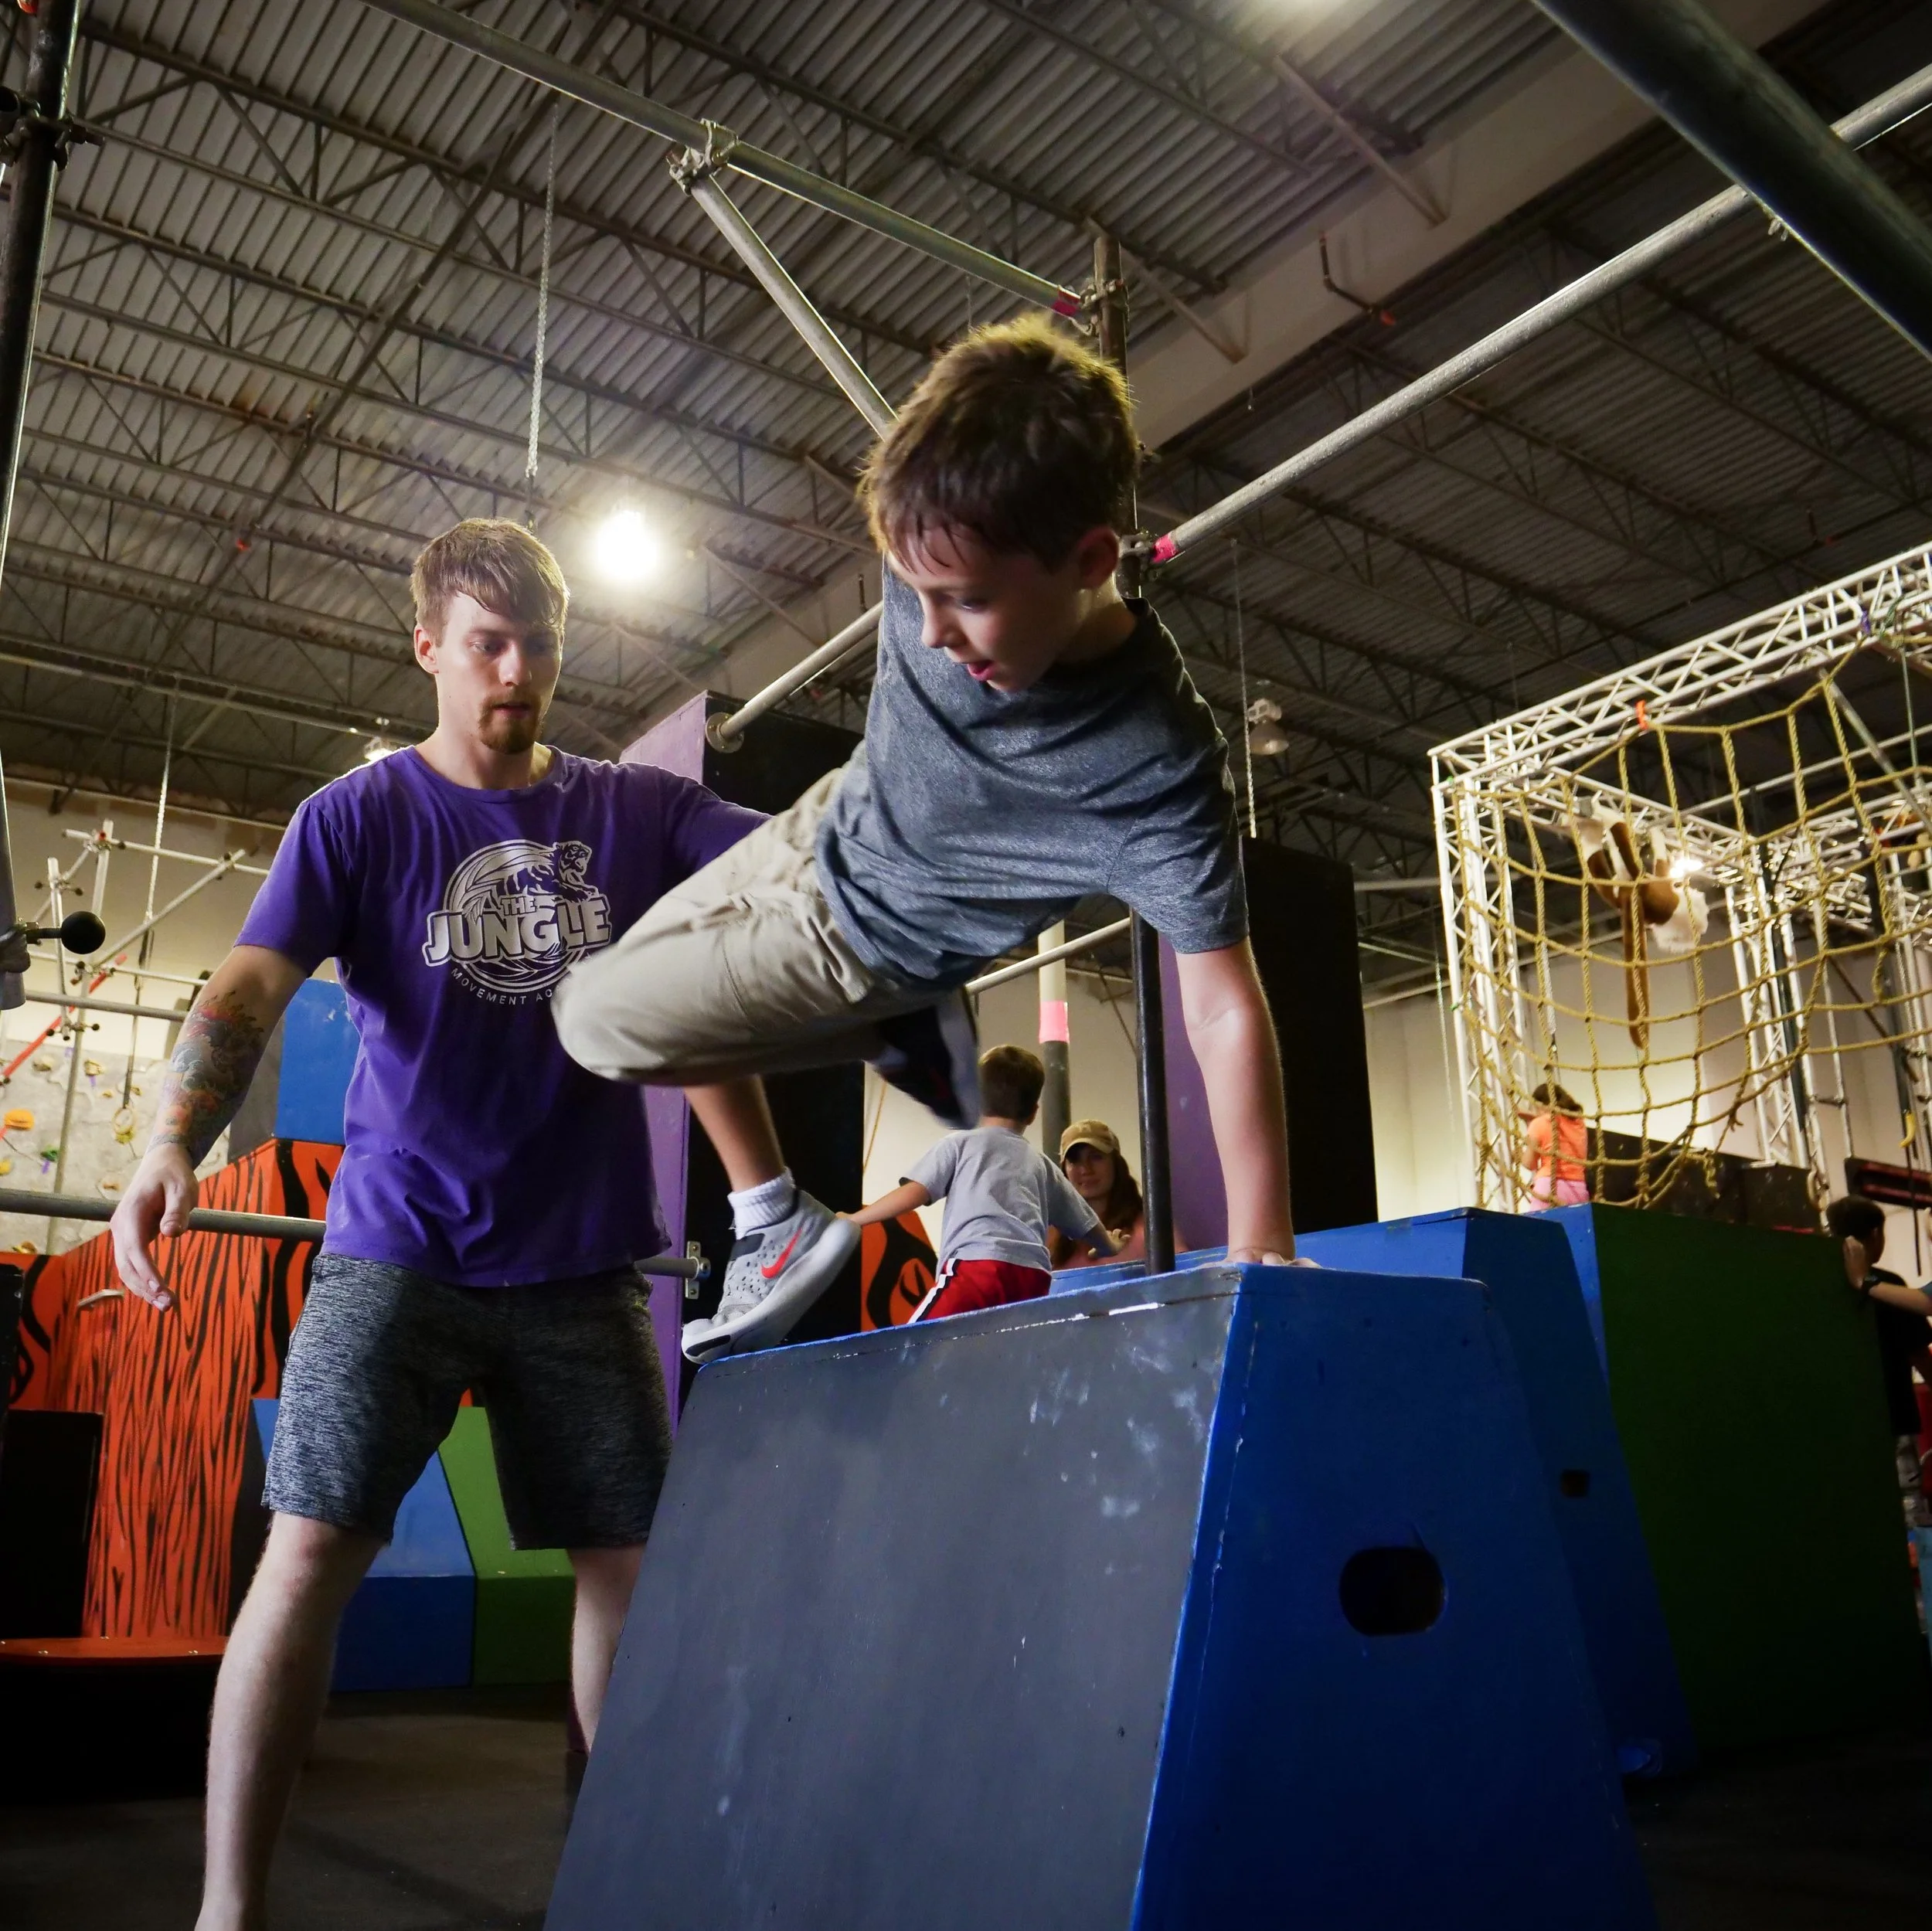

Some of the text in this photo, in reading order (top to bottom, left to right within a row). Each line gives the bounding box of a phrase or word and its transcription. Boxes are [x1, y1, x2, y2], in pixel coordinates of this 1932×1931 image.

[502, 896, 536, 916] THE
[424, 896, 611, 964] JUNGLE
[451, 967, 527, 1005] MOVEMENT
